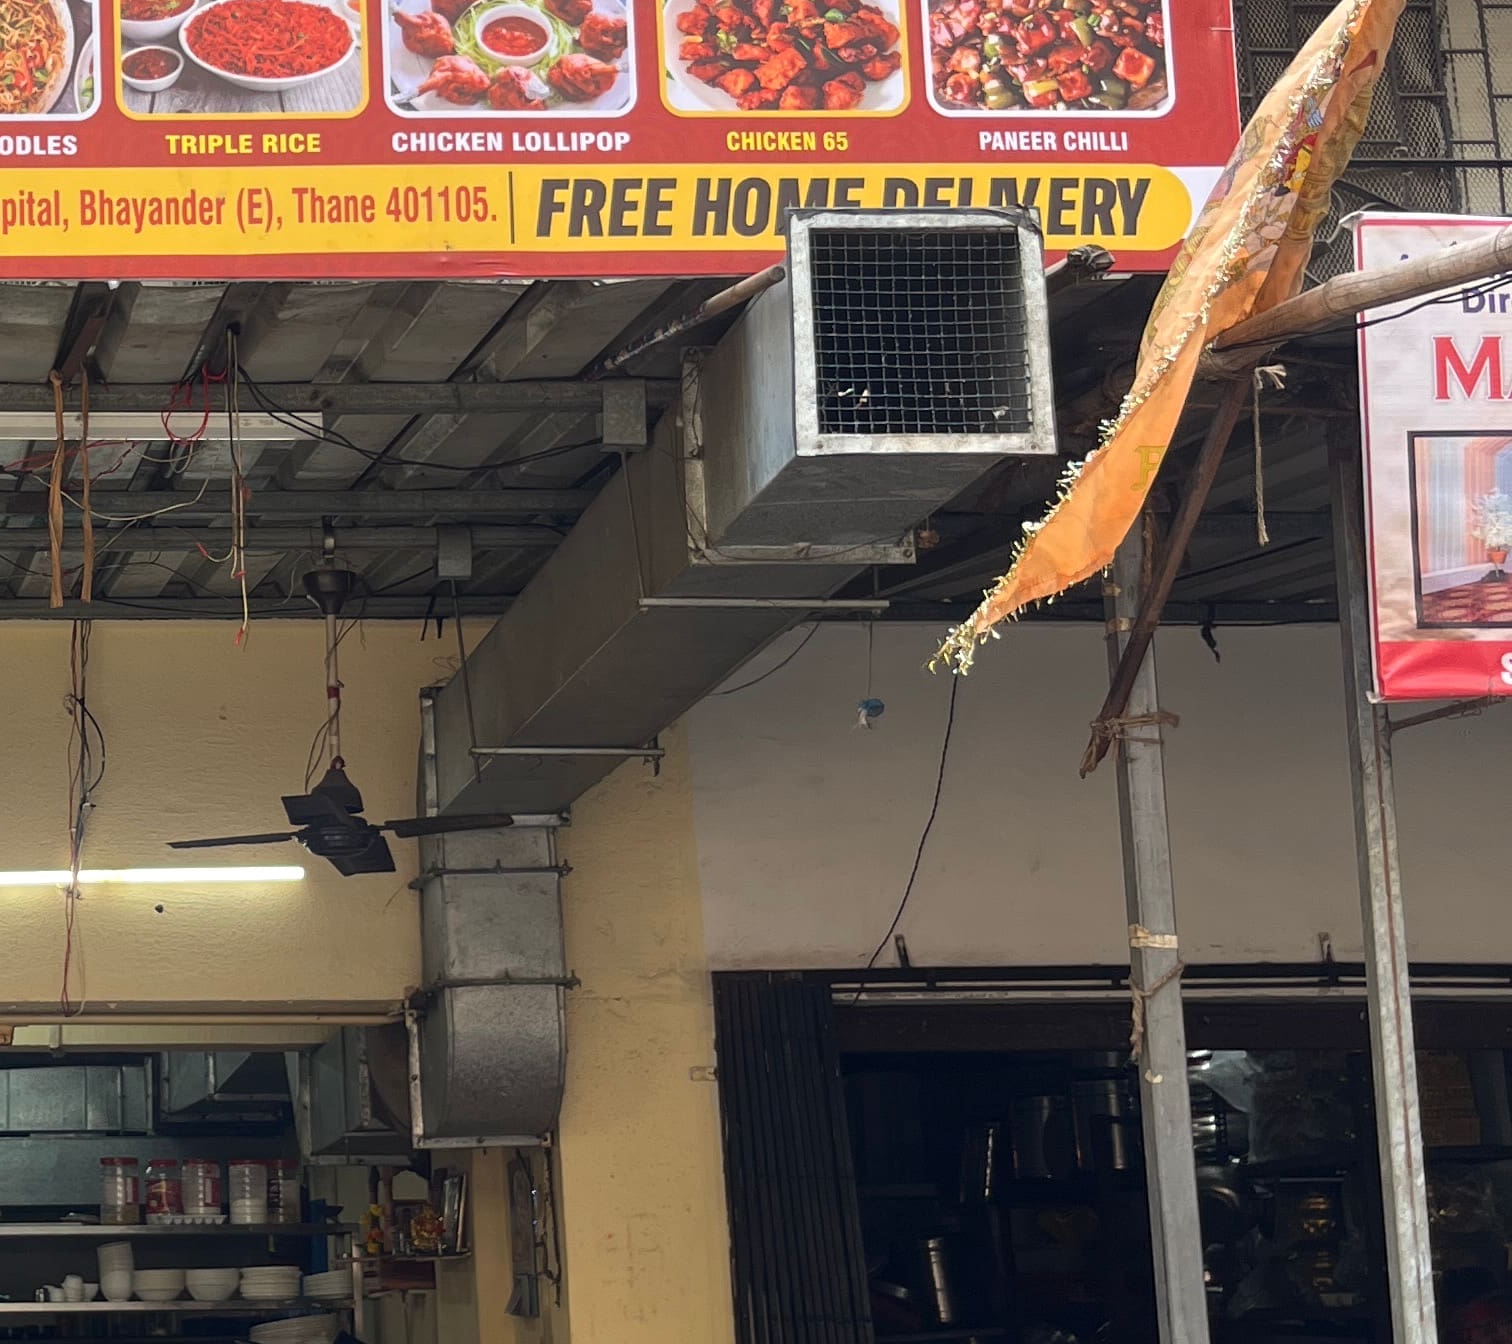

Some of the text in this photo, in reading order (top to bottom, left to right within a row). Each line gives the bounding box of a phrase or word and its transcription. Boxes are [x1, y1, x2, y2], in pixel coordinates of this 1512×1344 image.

[166, 134, 320, 154] TRIPLE RICE
[392, 132, 630, 152] CHICKEN LOLLIPOP
[727, 131, 848, 152] CHICKEN 65
[980, 131, 1127, 150] PANEER CHILLI
[80, 190, 225, 233] Bhayander
[238, 189, 281, 232] (E),
[293, 188, 374, 223] Thane
[387, 186, 496, 222] 401105.
[1433, 336, 1512, 400] M
